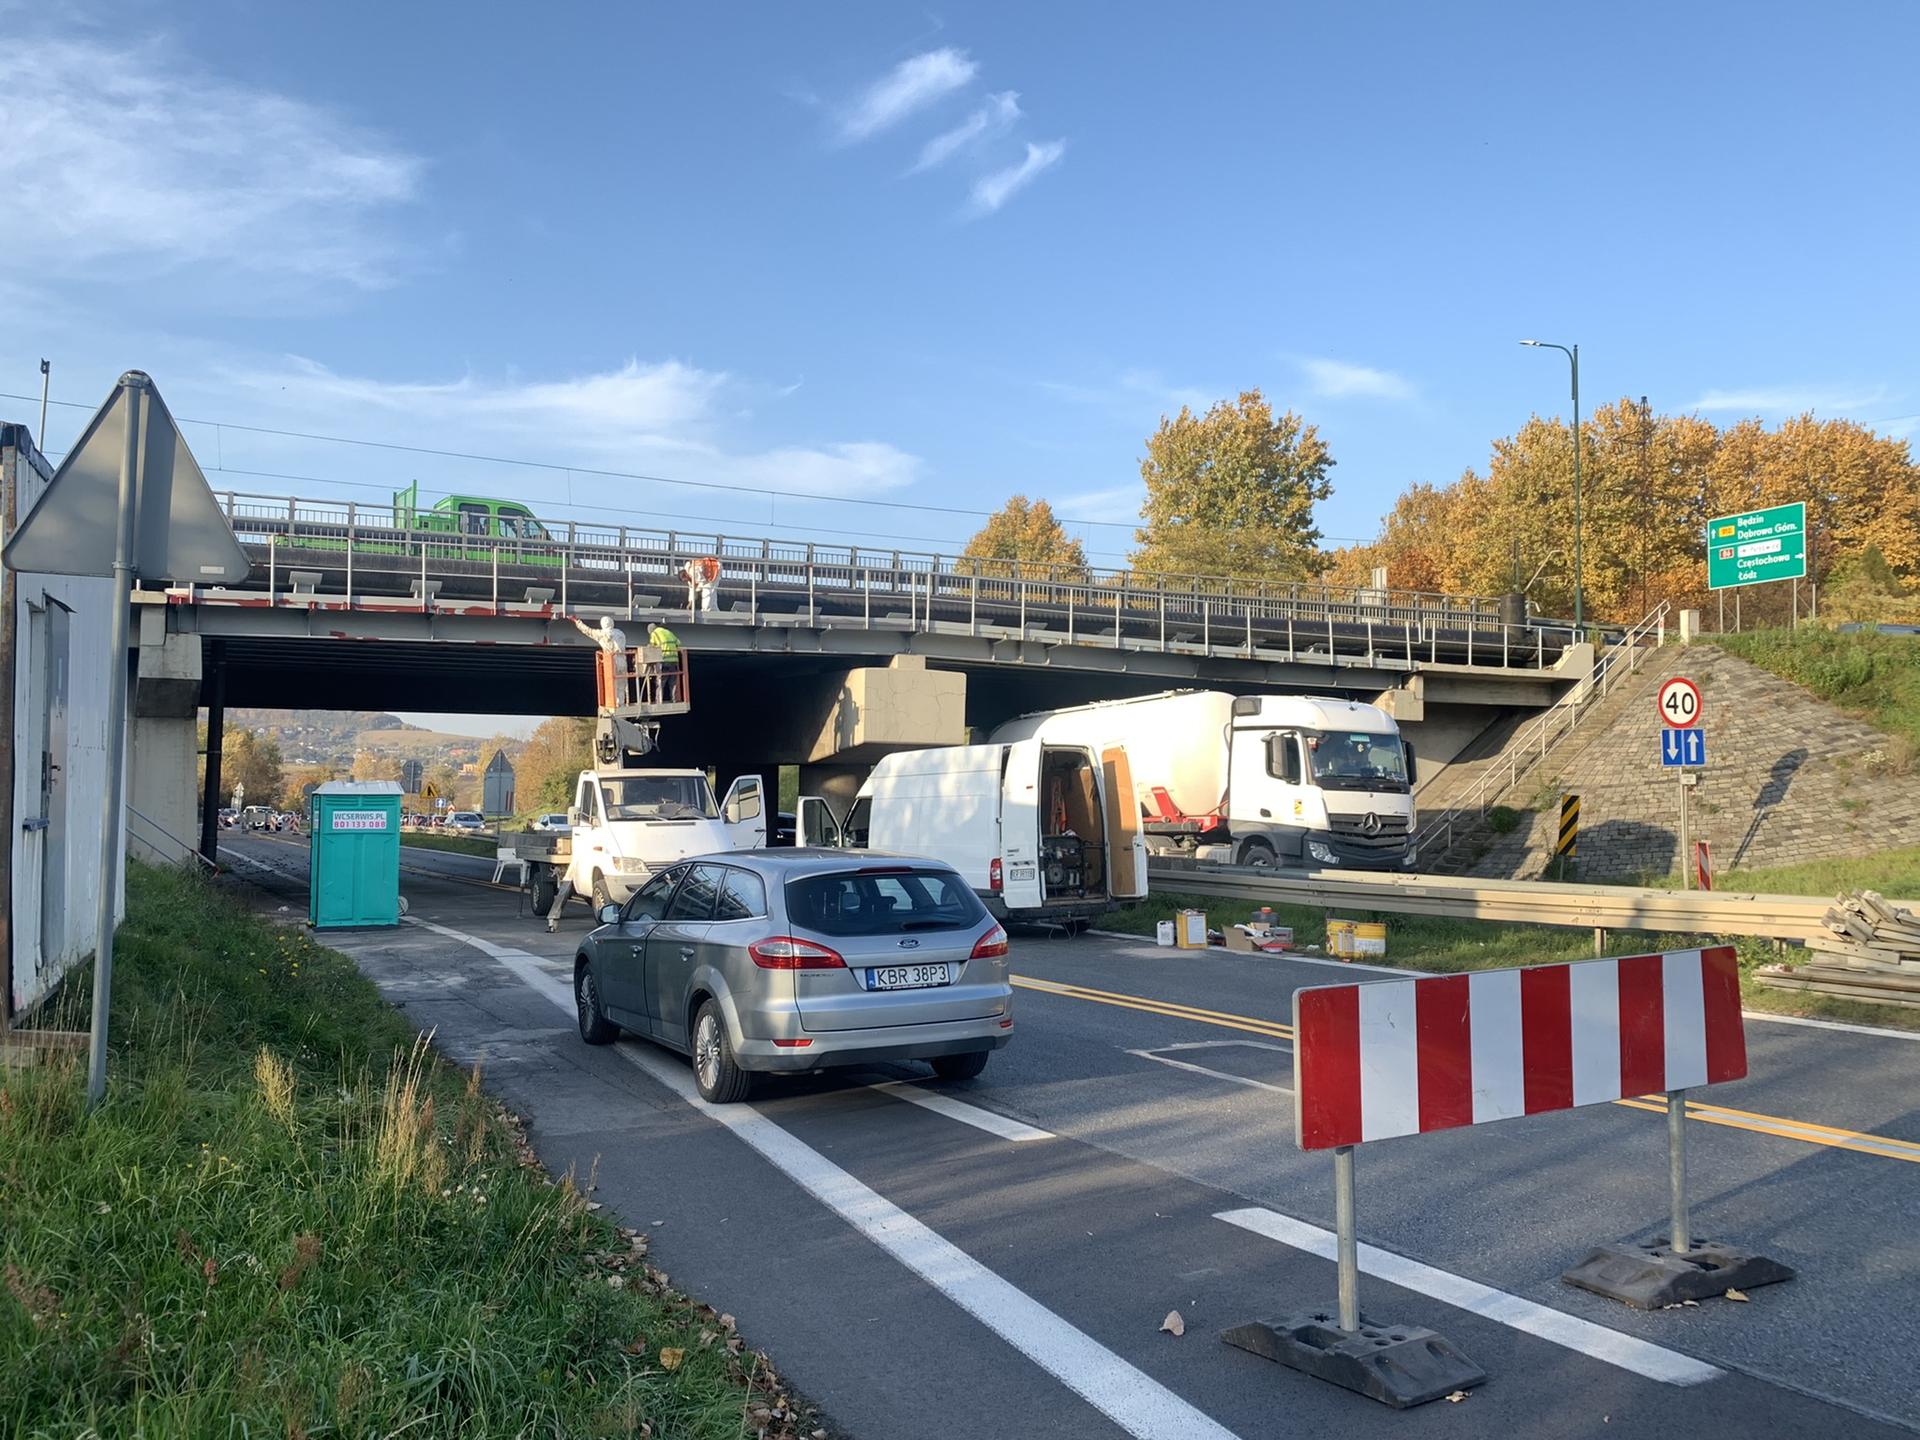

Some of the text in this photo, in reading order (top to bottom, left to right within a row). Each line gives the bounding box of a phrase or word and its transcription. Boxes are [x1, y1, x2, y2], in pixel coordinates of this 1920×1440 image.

[1737, 515, 1764, 527] Będzin
[1737, 527, 1773, 539] Dąbrowa
[1774, 522, 1797, 533] Górn.
[1737, 554, 1790, 568] Częstochowa
[1665, 691, 1695, 715] 40
[877, 966, 946, 985] KBR 38P3
